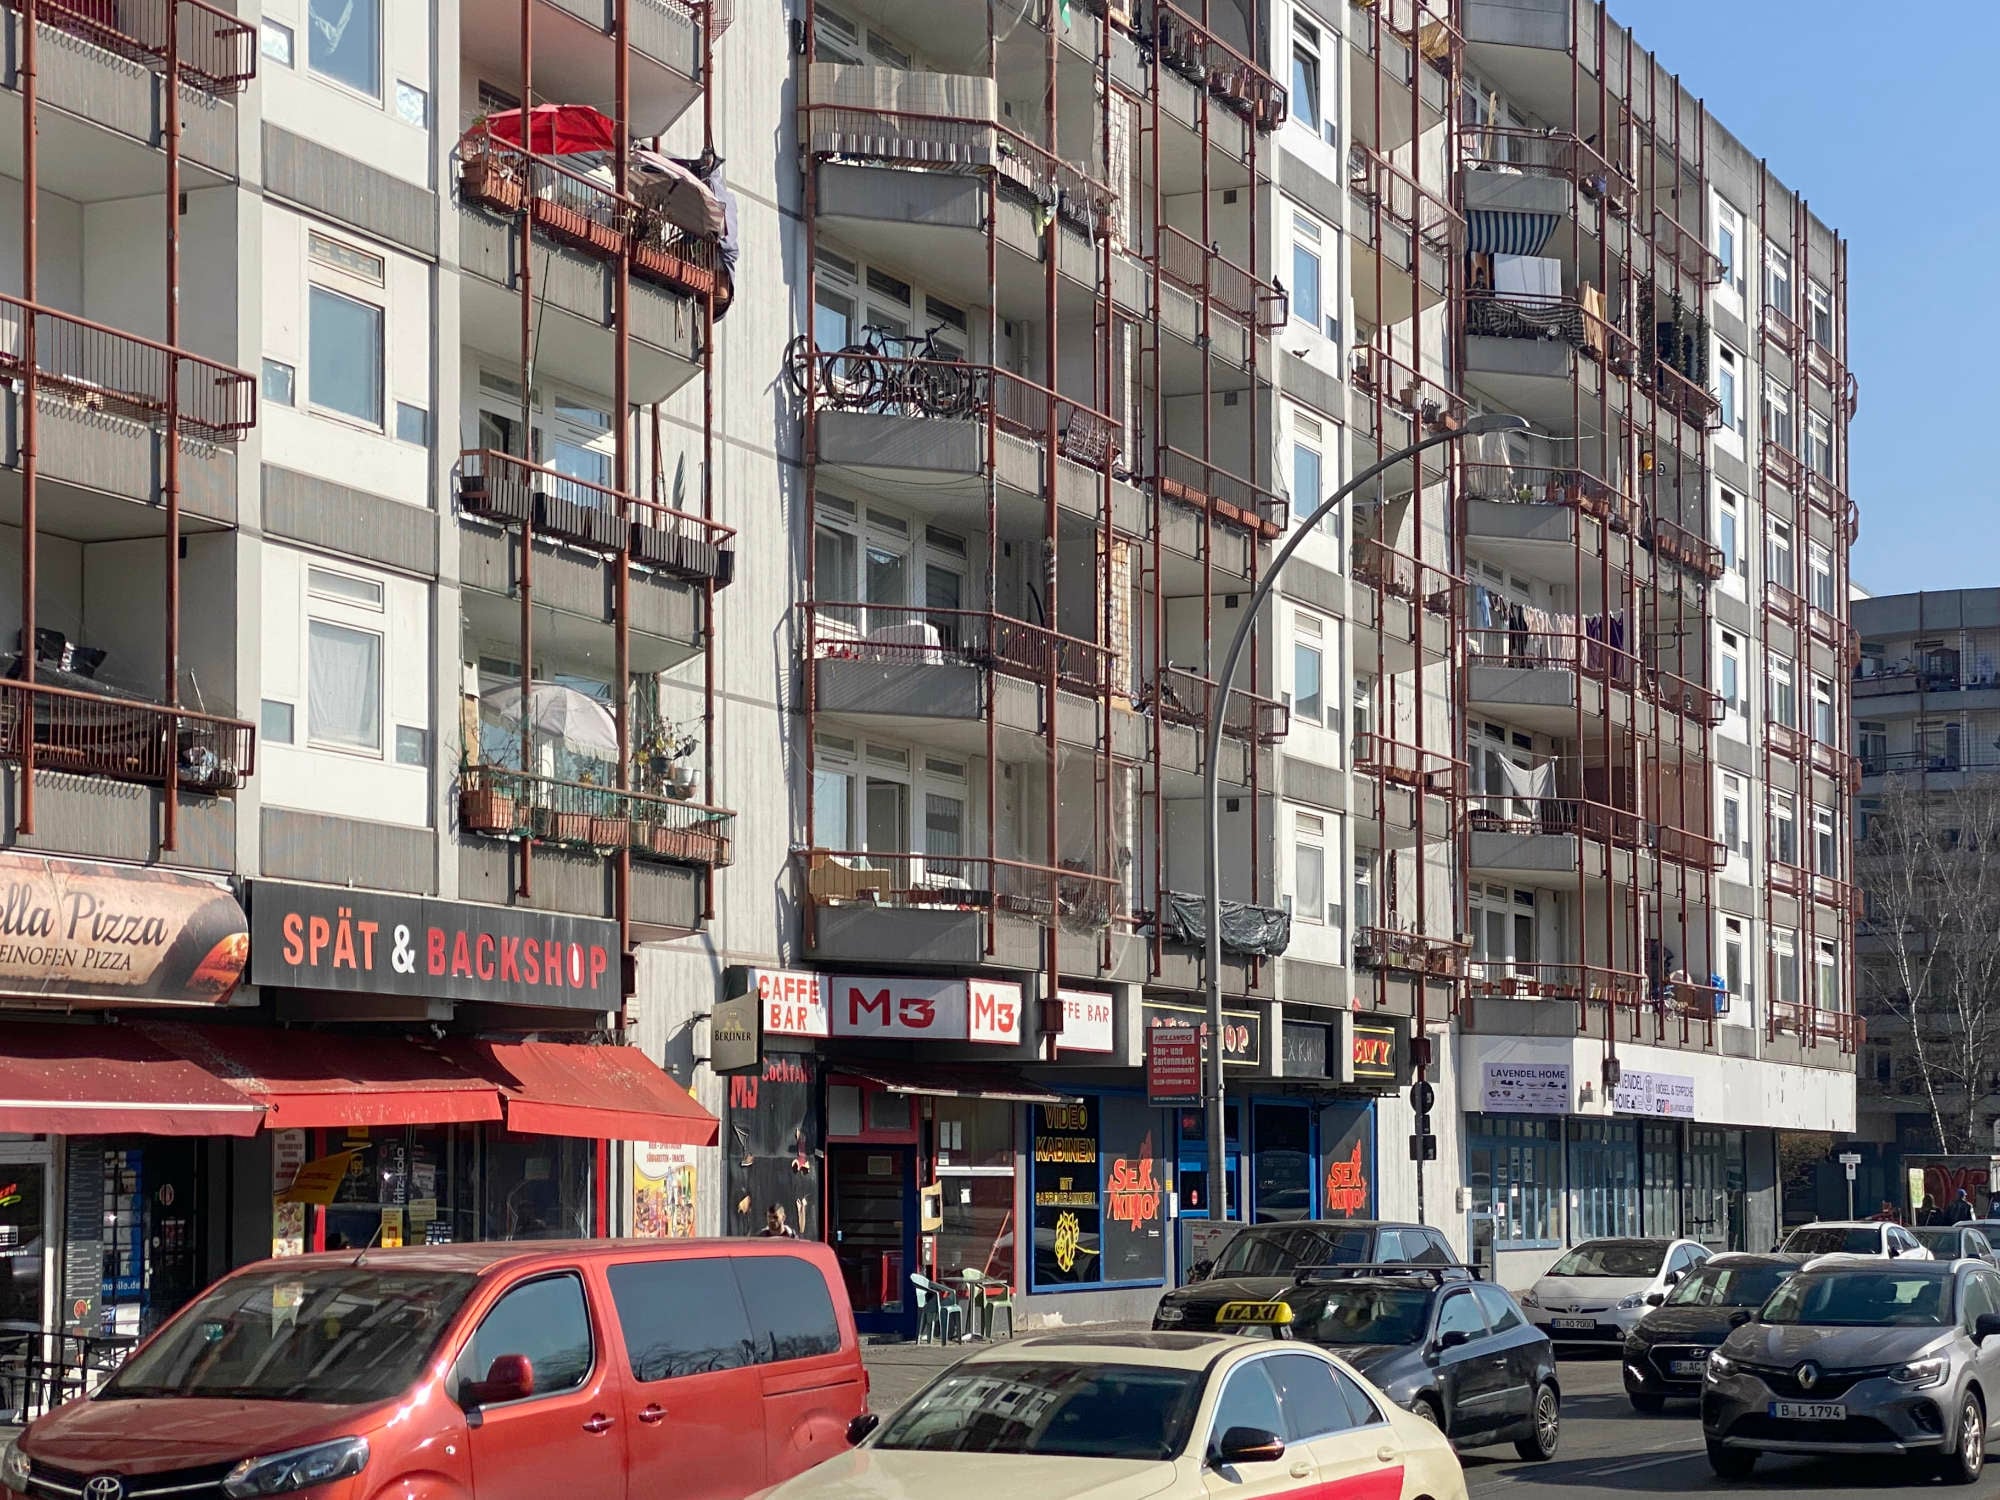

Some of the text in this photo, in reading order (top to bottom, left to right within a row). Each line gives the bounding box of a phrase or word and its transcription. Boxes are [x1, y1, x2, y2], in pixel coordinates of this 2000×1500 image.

[65, 891, 168, 946] Pizza
[82, 947, 131, 971] PIZZA
[283, 907, 607, 989] SPÄT & BACKSHOP
[759, 975, 819, 1005] CAFFE
[770, 1004, 808, 1031] BAR
[849, 987, 936, 1028] M3
[975, 993, 1014, 1032] M3
[1087, 1005, 1109, 1023] BAR
[714, 1030, 752, 1042] BERLINER
[1490, 1069, 1565, 1079] LAVENDEL HOME
[1044, 1103, 1088, 1130] VIDEO
[1035, 1136, 1096, 1163] KABINEN
[1113, 1158, 1153, 1191] SEX
[1331, 1161, 1361, 1188] SEX
[102, 1281, 141, 1290] moile.de
[1229, 1305, 1276, 1319] TAXI
[1781, 1405, 1789, 1416] B
[1809, 1406, 1841, 1418] 1794
